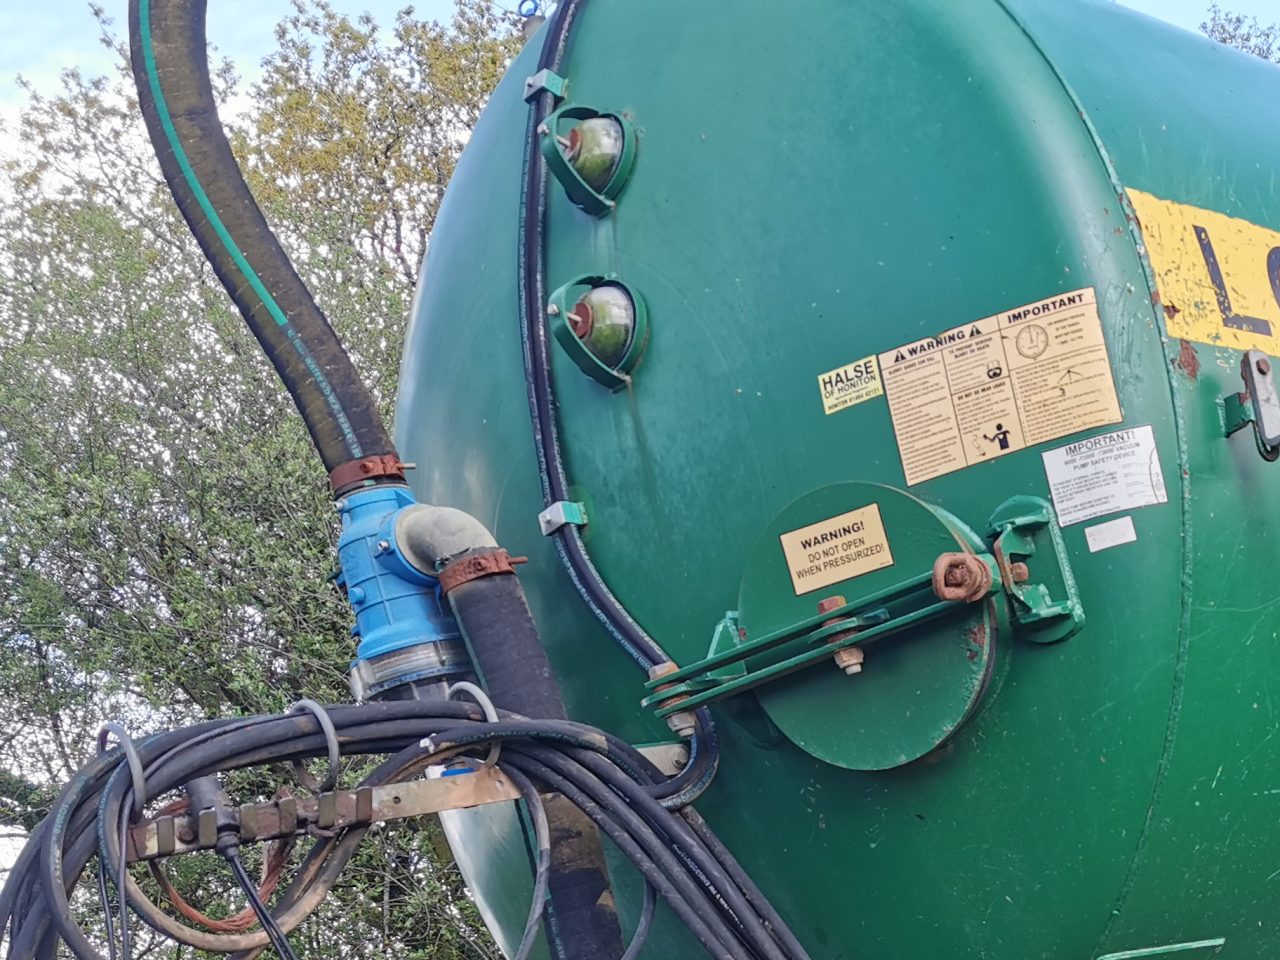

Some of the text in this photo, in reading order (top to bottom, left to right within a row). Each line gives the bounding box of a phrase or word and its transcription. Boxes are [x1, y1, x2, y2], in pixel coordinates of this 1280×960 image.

[1007, 293, 1084, 324] IMPORTANT
[907, 330, 966, 357] WARNING
[822, 360, 874, 391] HALSE
[824, 389, 835, 399] OF
[837, 374, 877, 394] HONITON
[1065, 430, 1136, 456] IMPORTANT!
[800, 520, 865, 550] WARNING!
[796, 543, 885, 580] WHEN PRESSURIZED!
[808, 537, 866, 563] DO NOT OPEN
